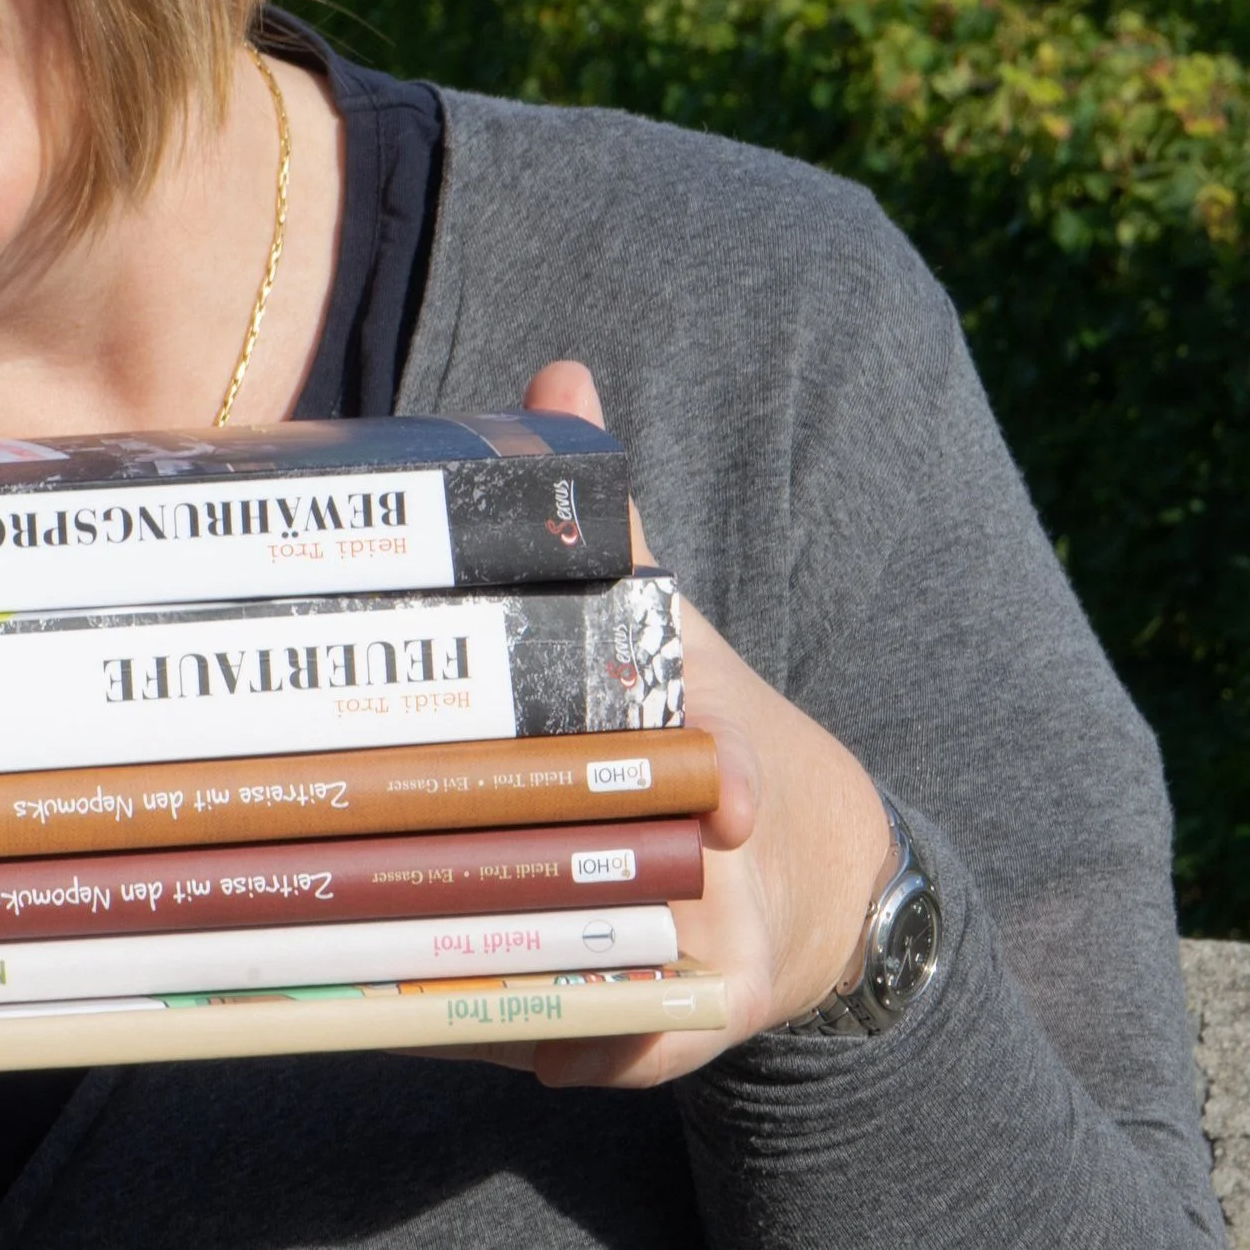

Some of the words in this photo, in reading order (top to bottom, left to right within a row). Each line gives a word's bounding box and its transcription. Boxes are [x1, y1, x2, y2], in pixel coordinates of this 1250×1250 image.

[267, 543, 324, 561] Troi
[337, 538, 407, 556] Heidi
[103, 636, 473, 703] FEUERTAUFE
[336, 695, 390, 717] Troi
[403, 691, 471, 712] Heidi
[387, 777, 438, 792] Gasser
[443, 775, 470, 790] Evi
[494, 772, 525, 787] Troi
[529, 770, 573, 786] Heidi
[13, 786, 134, 824] Nepomuks
[143, 789, 184, 818] den
[194, 786, 230, 811] mit
[241, 781, 351, 809] Zeitreise
[372, 870, 424, 885] Gasser
[430, 867, 455, 882] Evi
[479, 864, 512, 879] Troi
[515, 862, 559, 878] Heidi
[121, 880, 164, 910] den
[173, 874, 211, 903] mit
[221, 871, 334, 900] Zeitreise
[433, 934, 476, 957] Troi
[483, 930, 541, 951] Heidi
[448, 998, 491, 1026] Troi
[500, 994, 562, 1022] Heidi
